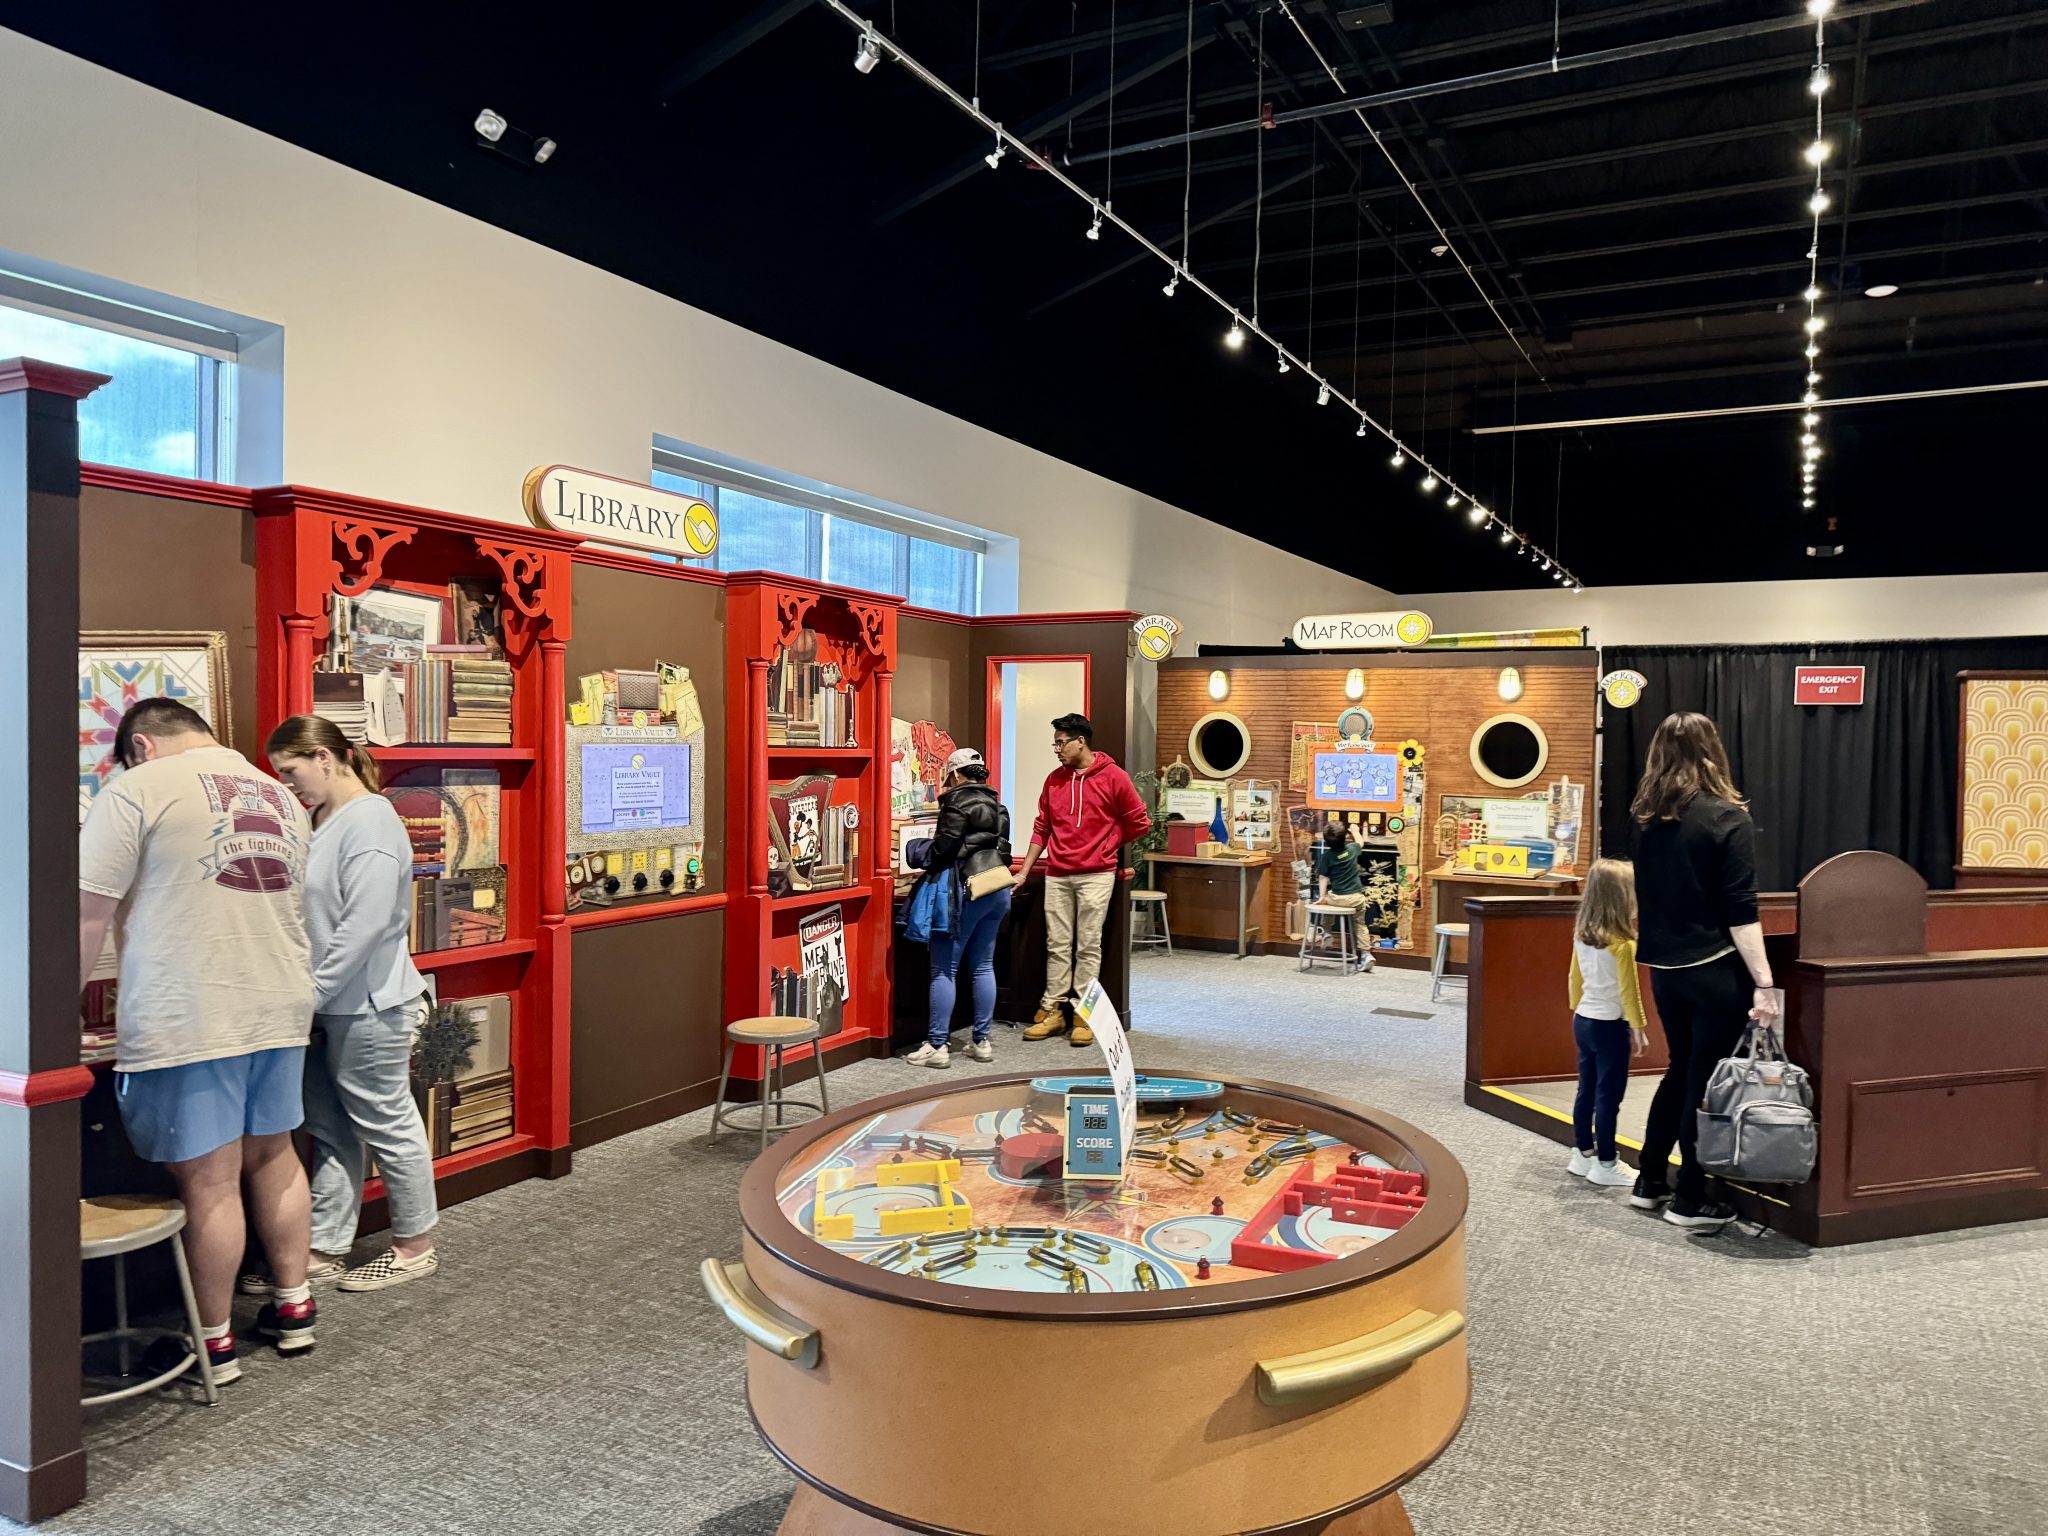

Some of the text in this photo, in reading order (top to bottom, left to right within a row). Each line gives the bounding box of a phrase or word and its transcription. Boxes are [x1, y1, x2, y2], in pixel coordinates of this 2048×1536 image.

[554, 478, 681, 540] LIBRARY
[1135, 617, 1176, 632] LIBRARY
[1300, 621, 1394, 640] MAP ROOM
[1602, 671, 1643, 688] MAP ROOM
[1801, 675, 1858, 684] EMERGENCY
[1818, 686, 1839, 694] EXIT
[615, 727, 665, 736] LIBRARY VAULT
[614, 770, 661, 779] LIBRARY VAULT
[223, 841, 243, 855] the
[804, 915, 840, 940] DANGER
[804, 942, 829, 971] MEN
[805, 957, 845, 986] RING
[1081, 1104, 1109, 1115] TIME
[1076, 1137, 1113, 1149] SCORE
